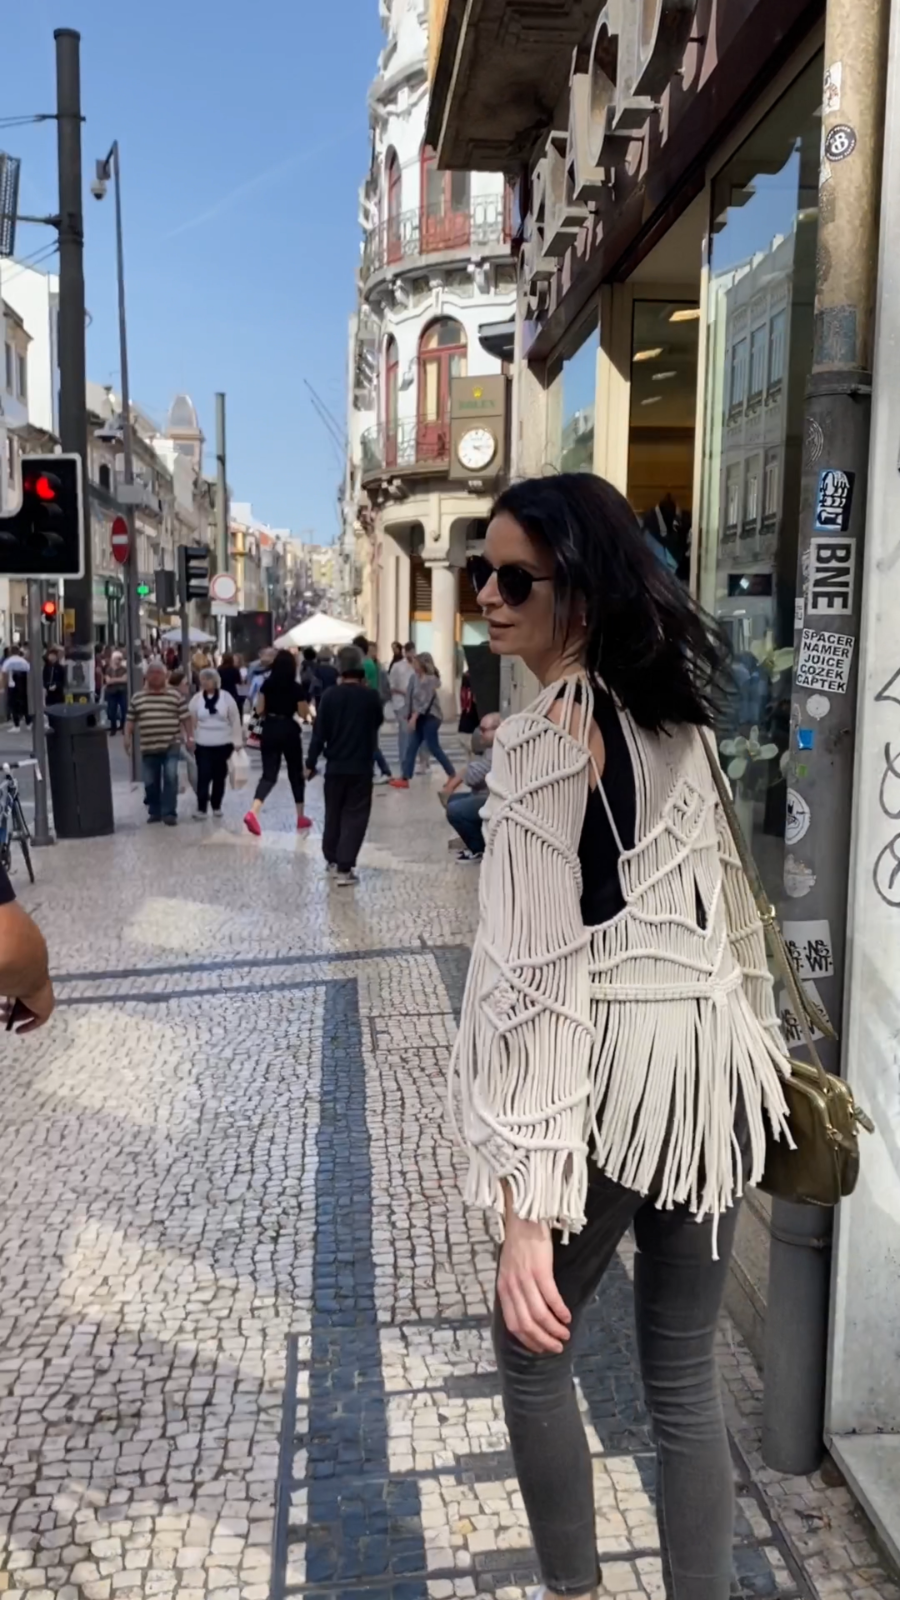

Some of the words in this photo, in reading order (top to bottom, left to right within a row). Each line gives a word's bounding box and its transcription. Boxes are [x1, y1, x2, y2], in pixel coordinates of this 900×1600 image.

[811, 543, 852, 609] BNE
[803, 630, 853, 648] SPACER
[803, 641, 849, 659] NAMER
[804, 654, 844, 669] JUICE
[800, 664, 844, 680] COZEK
[797, 674, 846, 692] CAPTEK
